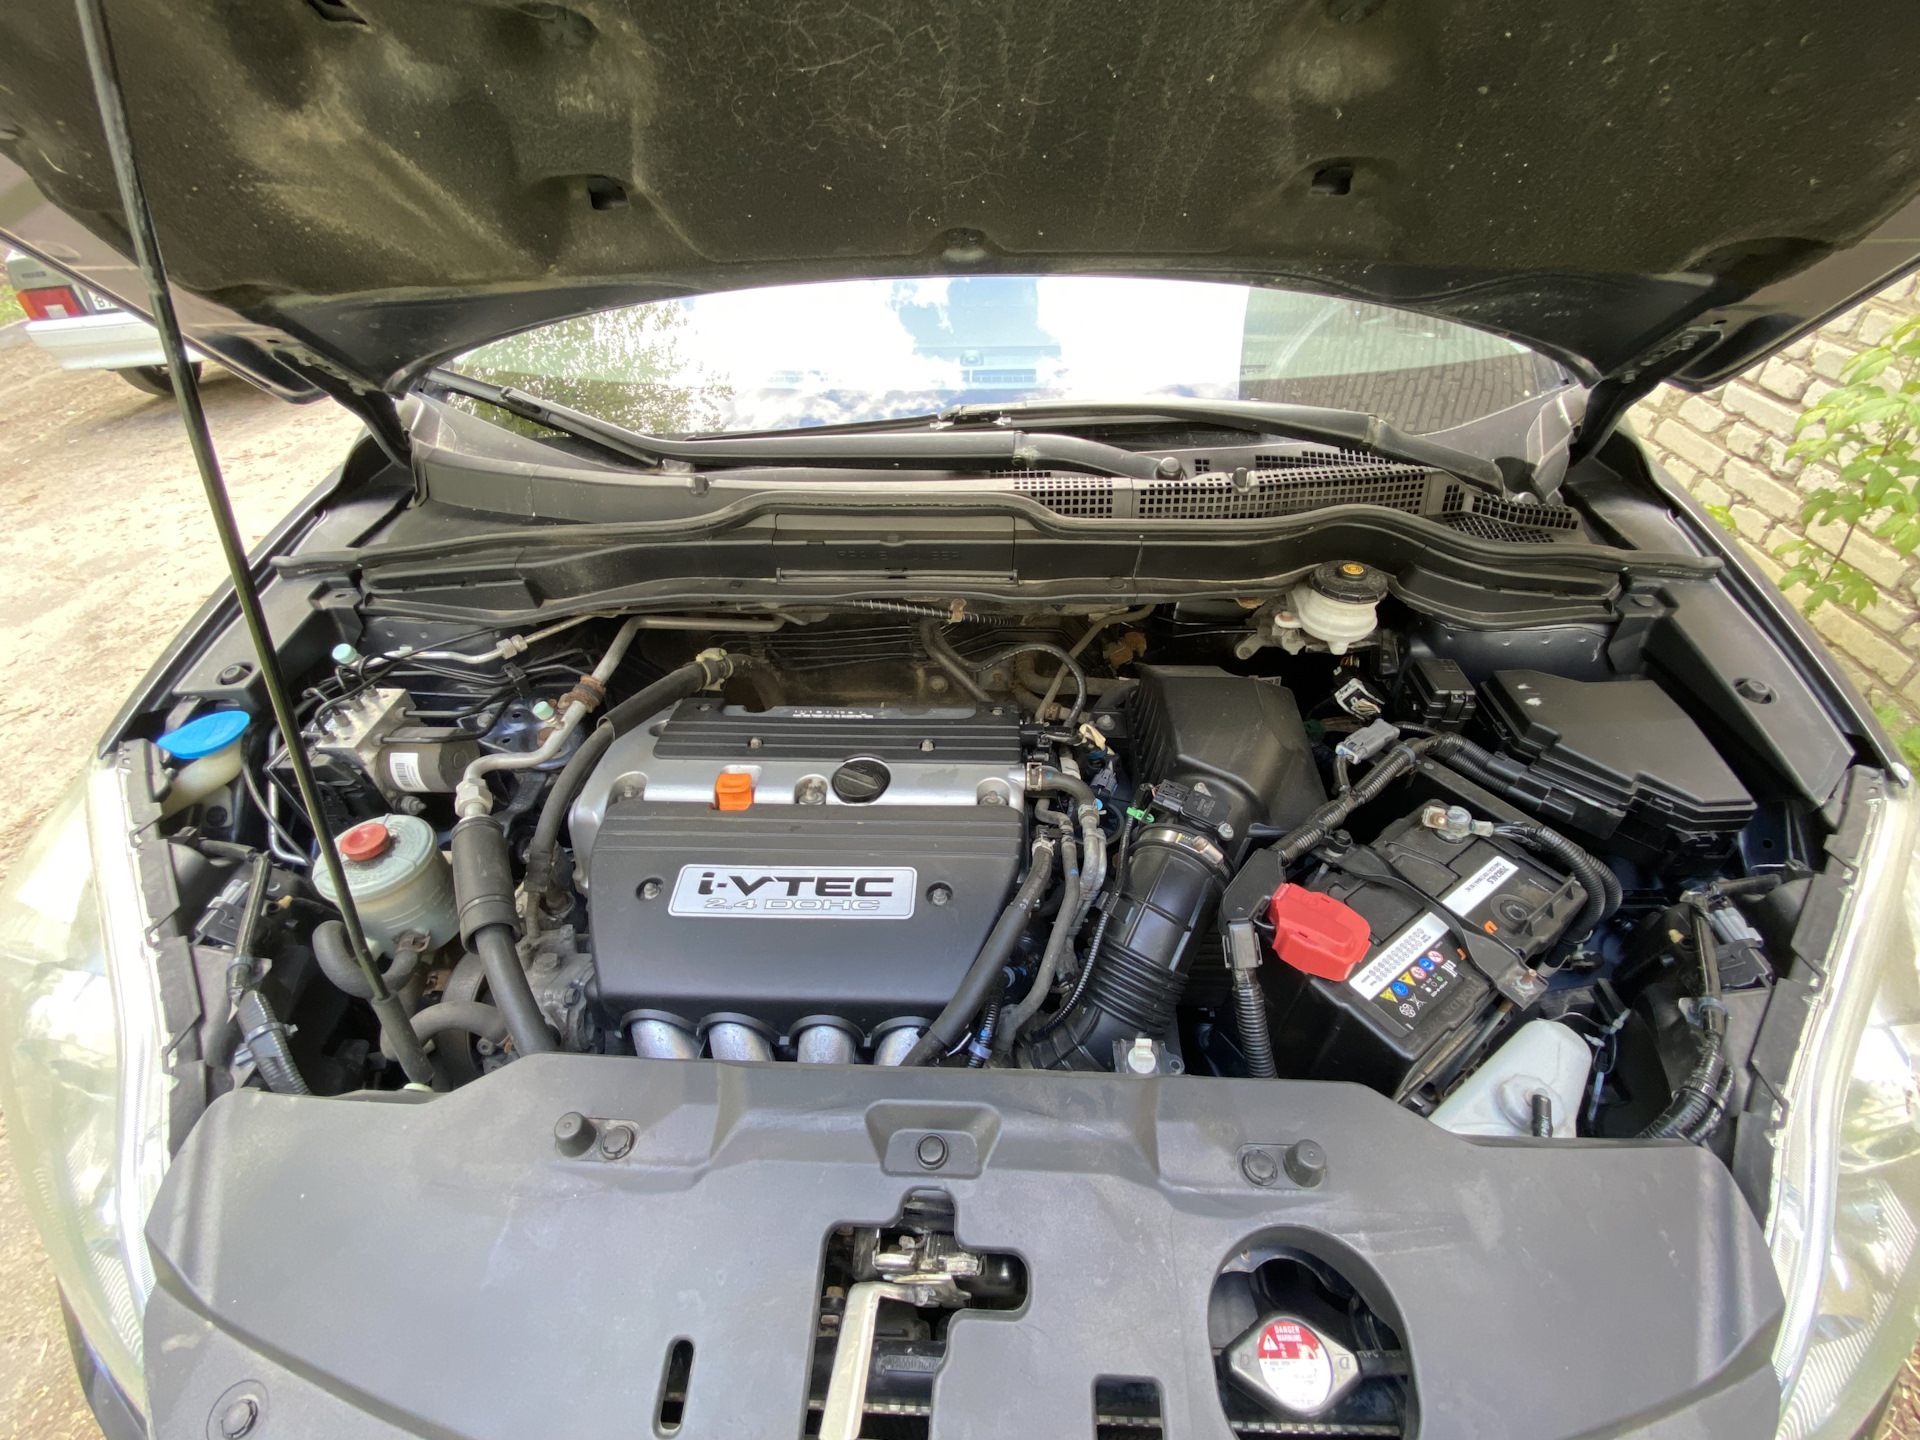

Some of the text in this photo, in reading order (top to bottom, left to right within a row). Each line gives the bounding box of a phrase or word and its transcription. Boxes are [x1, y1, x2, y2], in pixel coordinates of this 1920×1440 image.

[698, 871, 894, 897] i-VTEC
[704, 898, 880, 910] 2.4 DOHC
[1441, 979, 1483, 1016] HONDA
[1274, 1325, 1300, 1334] DANGER
